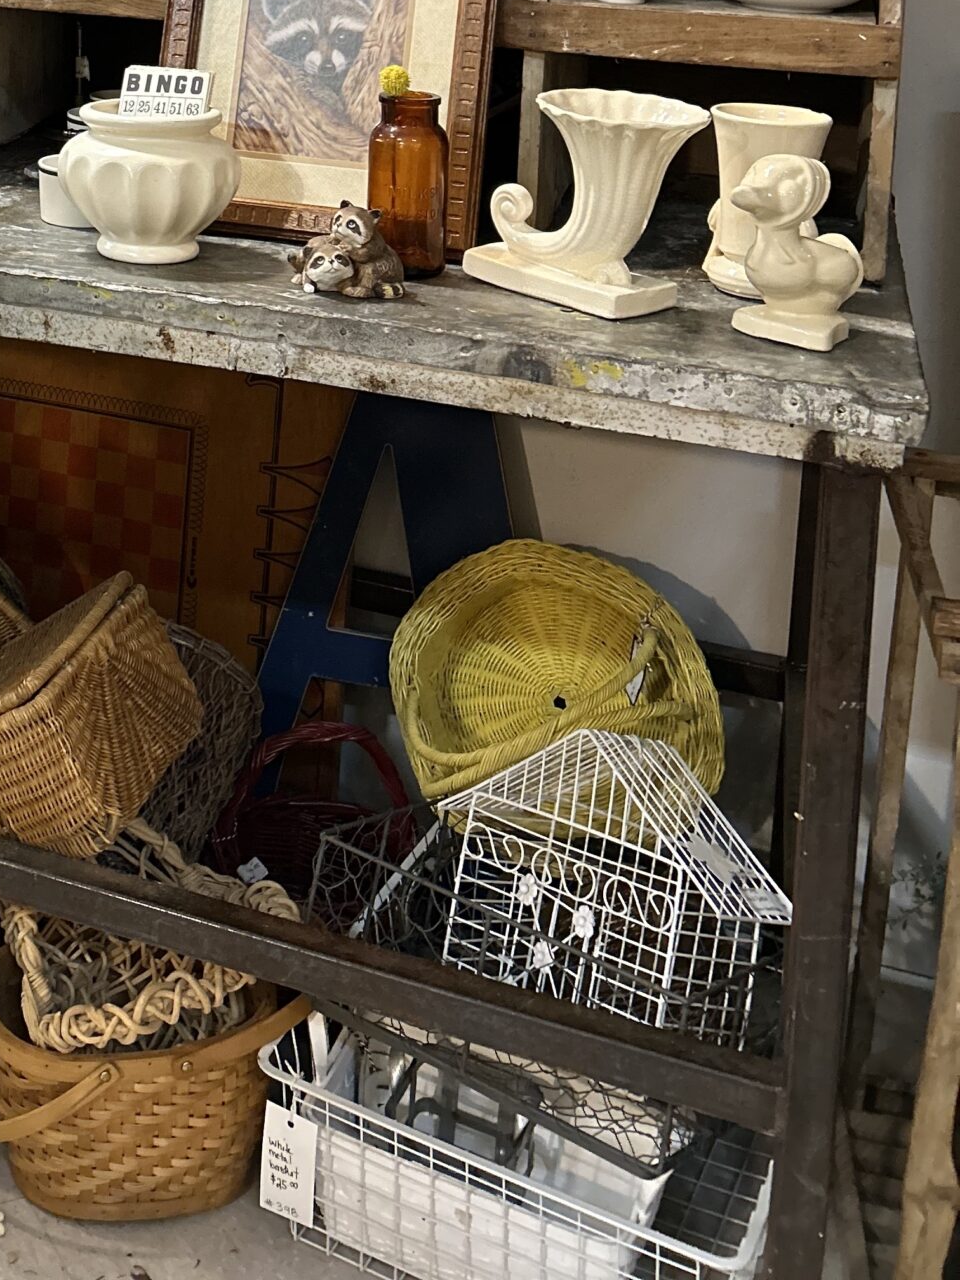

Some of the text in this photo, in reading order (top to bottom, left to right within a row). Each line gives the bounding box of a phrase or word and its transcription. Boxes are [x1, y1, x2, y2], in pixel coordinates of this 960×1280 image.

[126, 73, 204, 95] BINGO
[123, 100, 200, 116] 12 25 41 51 63
[268, 1148, 292, 1165] metal
